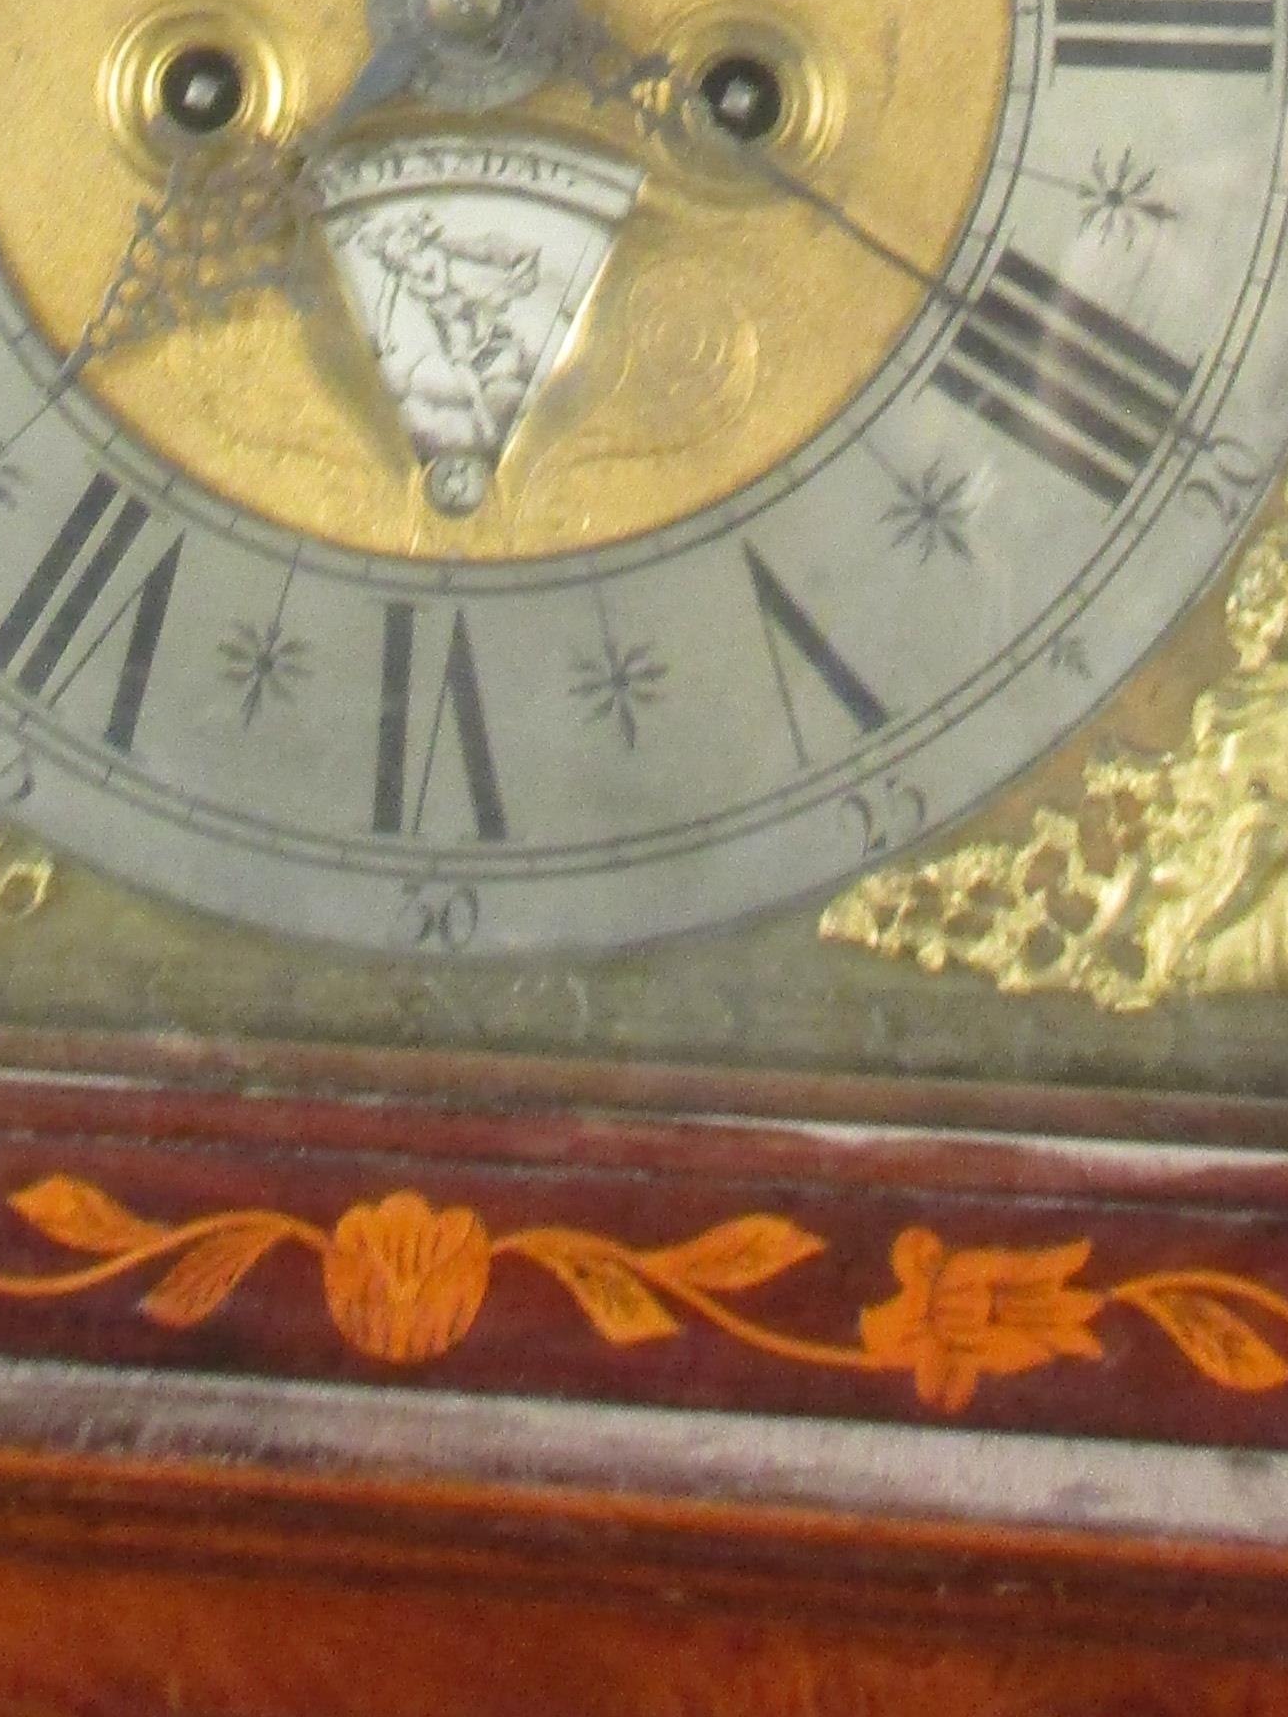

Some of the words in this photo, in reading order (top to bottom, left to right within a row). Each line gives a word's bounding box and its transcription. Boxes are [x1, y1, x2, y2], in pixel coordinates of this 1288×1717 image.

[918, 233, 1204, 517] IIII
[370, 599, 509, 842] VI
[742, 536, 893, 769] V
